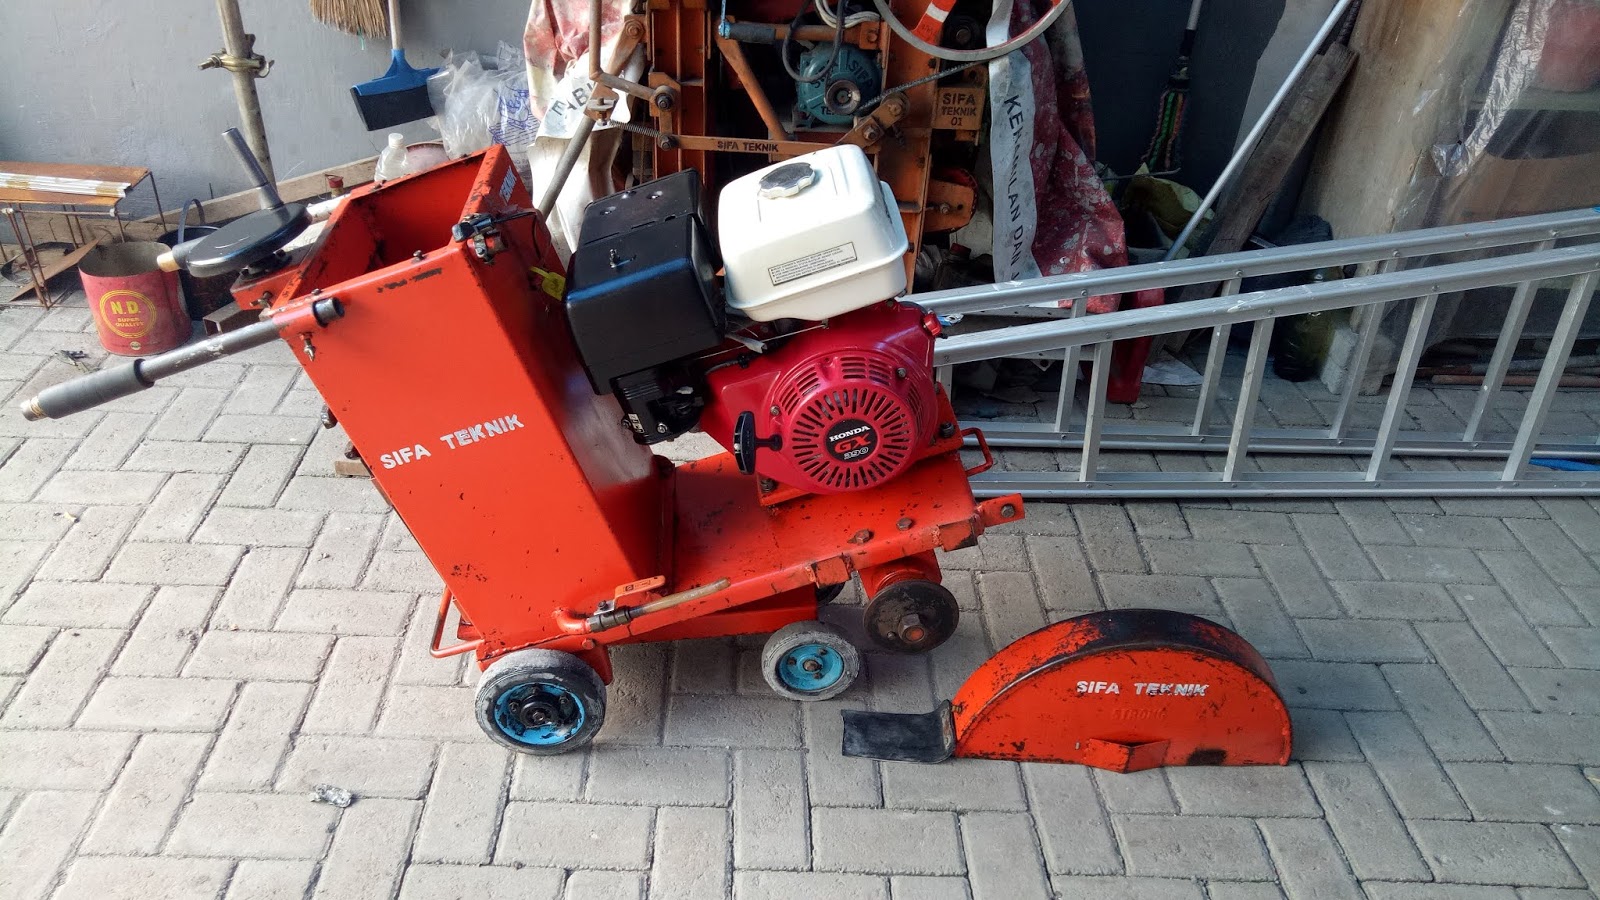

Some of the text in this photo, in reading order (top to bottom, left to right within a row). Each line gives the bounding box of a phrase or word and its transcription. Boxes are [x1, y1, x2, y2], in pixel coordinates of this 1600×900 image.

[943, 93, 976, 105] SIFA
[941, 106, 977, 116] TEKNIK
[717, 141, 779, 153] SIFA TEKNIK
[1011, 224, 1024, 267] DAN
[829, 425, 871, 442] HONDA
[380, 414, 525, 470] SIFA TEKNIK
[834, 432, 872, 454] GX
[1076, 680, 1209, 696] SIFA TEKNIK
